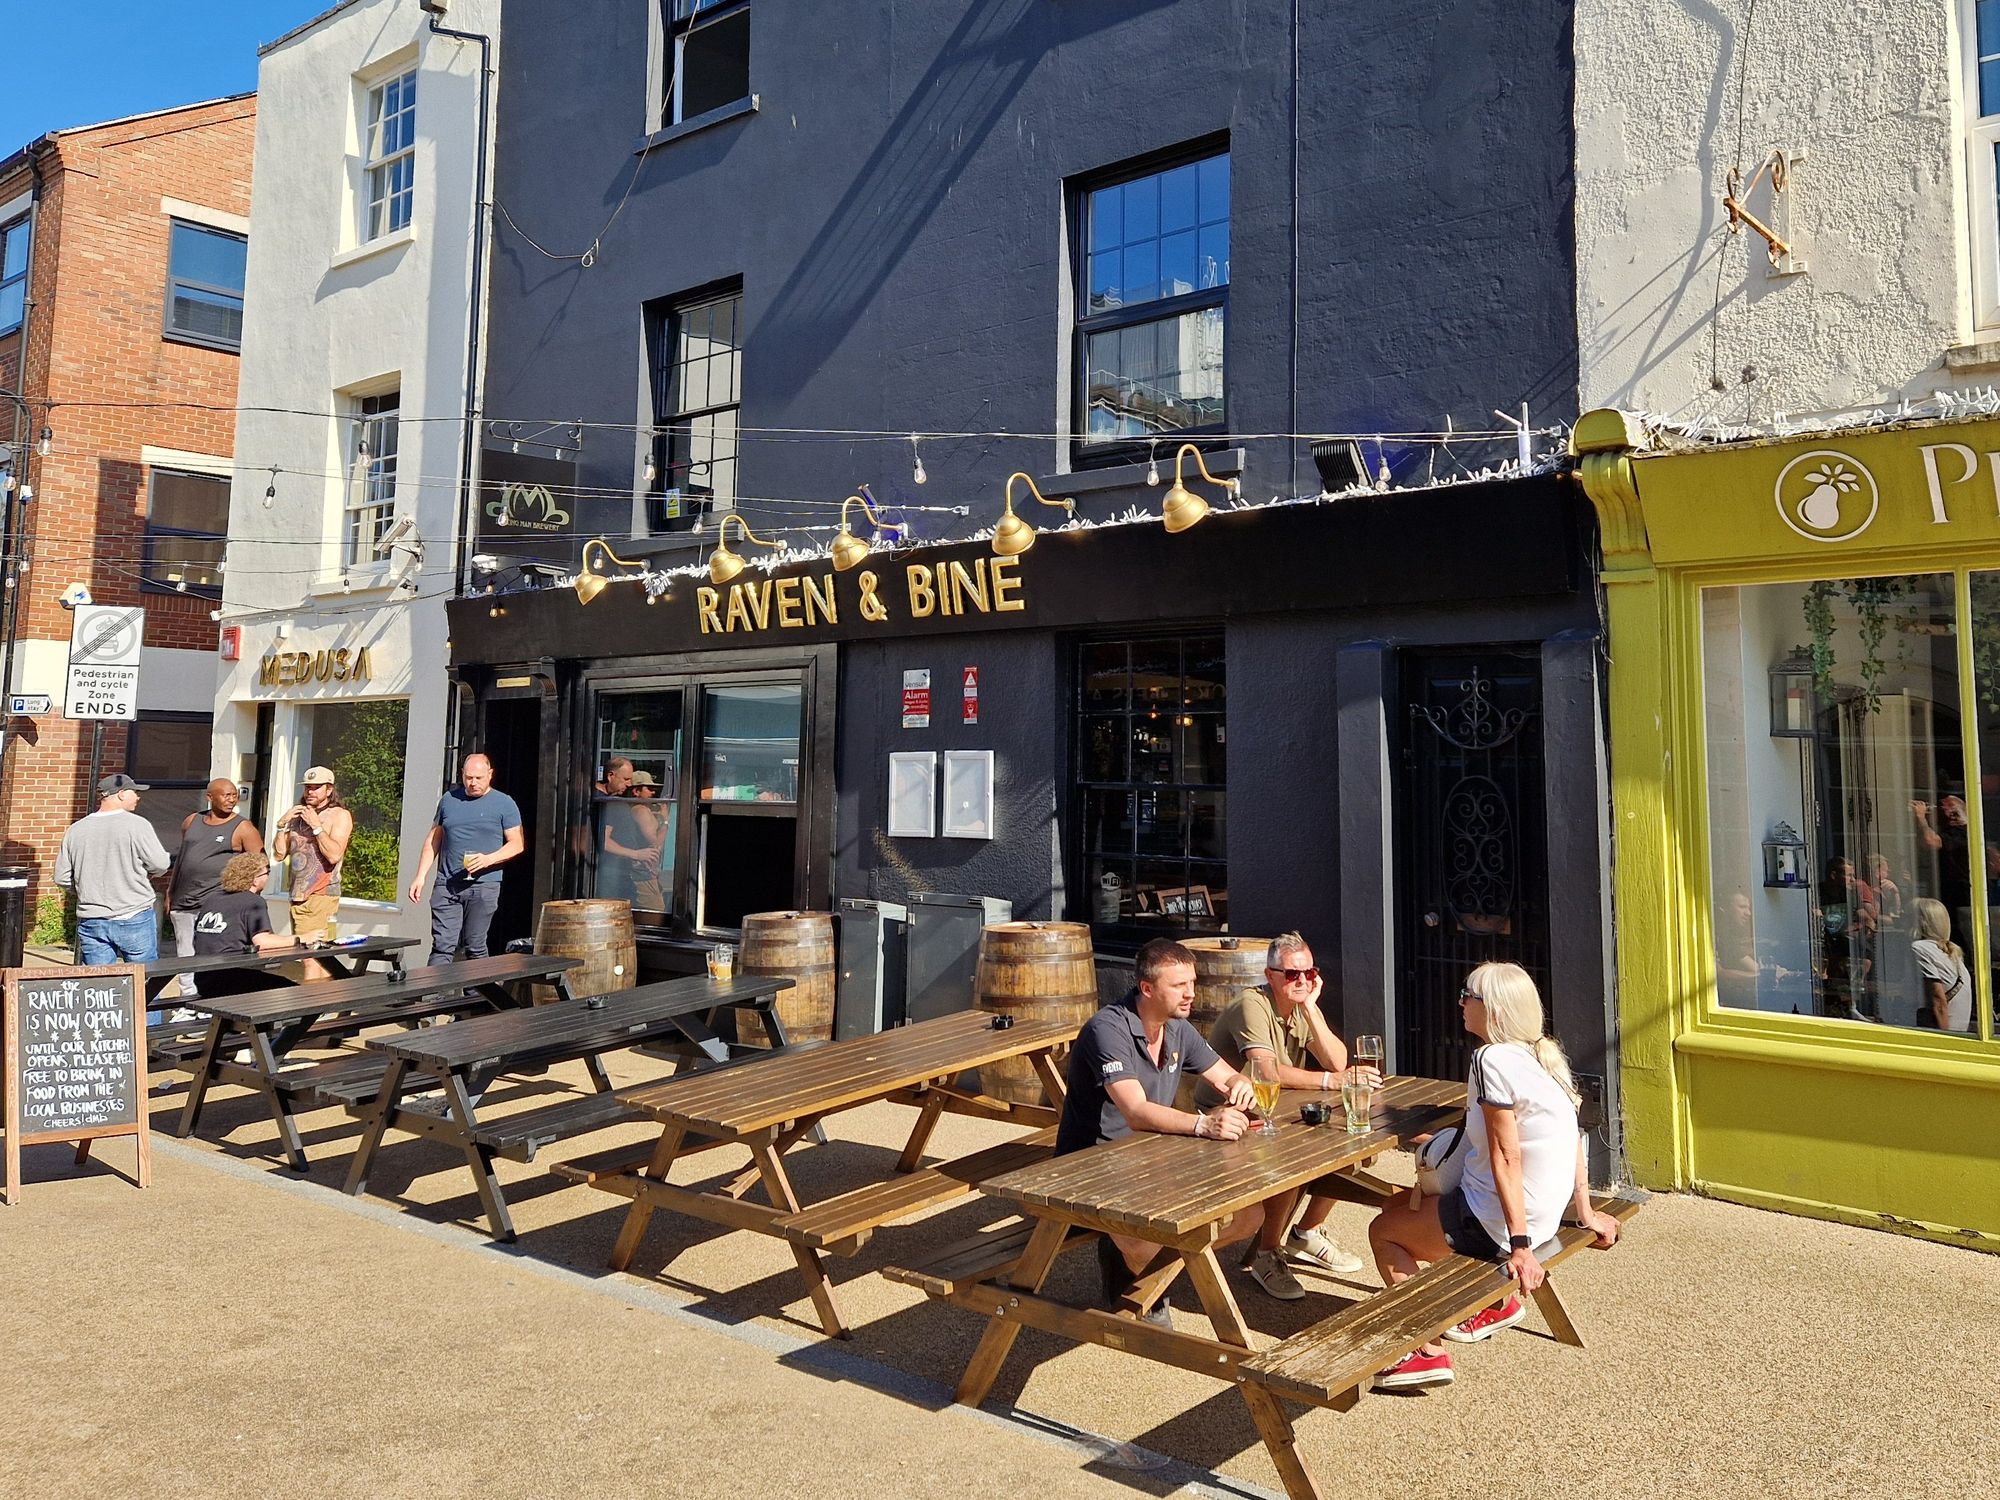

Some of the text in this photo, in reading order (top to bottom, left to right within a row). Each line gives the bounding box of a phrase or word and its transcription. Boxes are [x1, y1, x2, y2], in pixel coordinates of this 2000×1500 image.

[696, 555, 1025, 634] RAVEN & BINE
[74, 669, 134, 680] Pedestrian
[259, 646, 373, 687] MEDUSA
[77, 680, 129, 690] and cycle
[88, 690, 115, 700] Zone
[905, 691, 928, 699] Alarm
[75, 702, 127, 715] ENDS
[60, 980, 80, 992] the
[26, 990, 74, 1011] RAVEN
[84, 987, 123, 1009] BINE
[25, 1010, 123, 1032] IS NOW OPEN
[25, 1037, 130, 1055] UNTIL OUR KITCHEN
[73, 1052, 114, 1067] PLEASE
[23, 1066, 123, 1085] FREE TO BRING IN
[26, 1086, 56, 1104] FOOD
[92, 1082, 114, 1097] THE
[24, 1098, 125, 1118] LOCAL BUSINESSES
